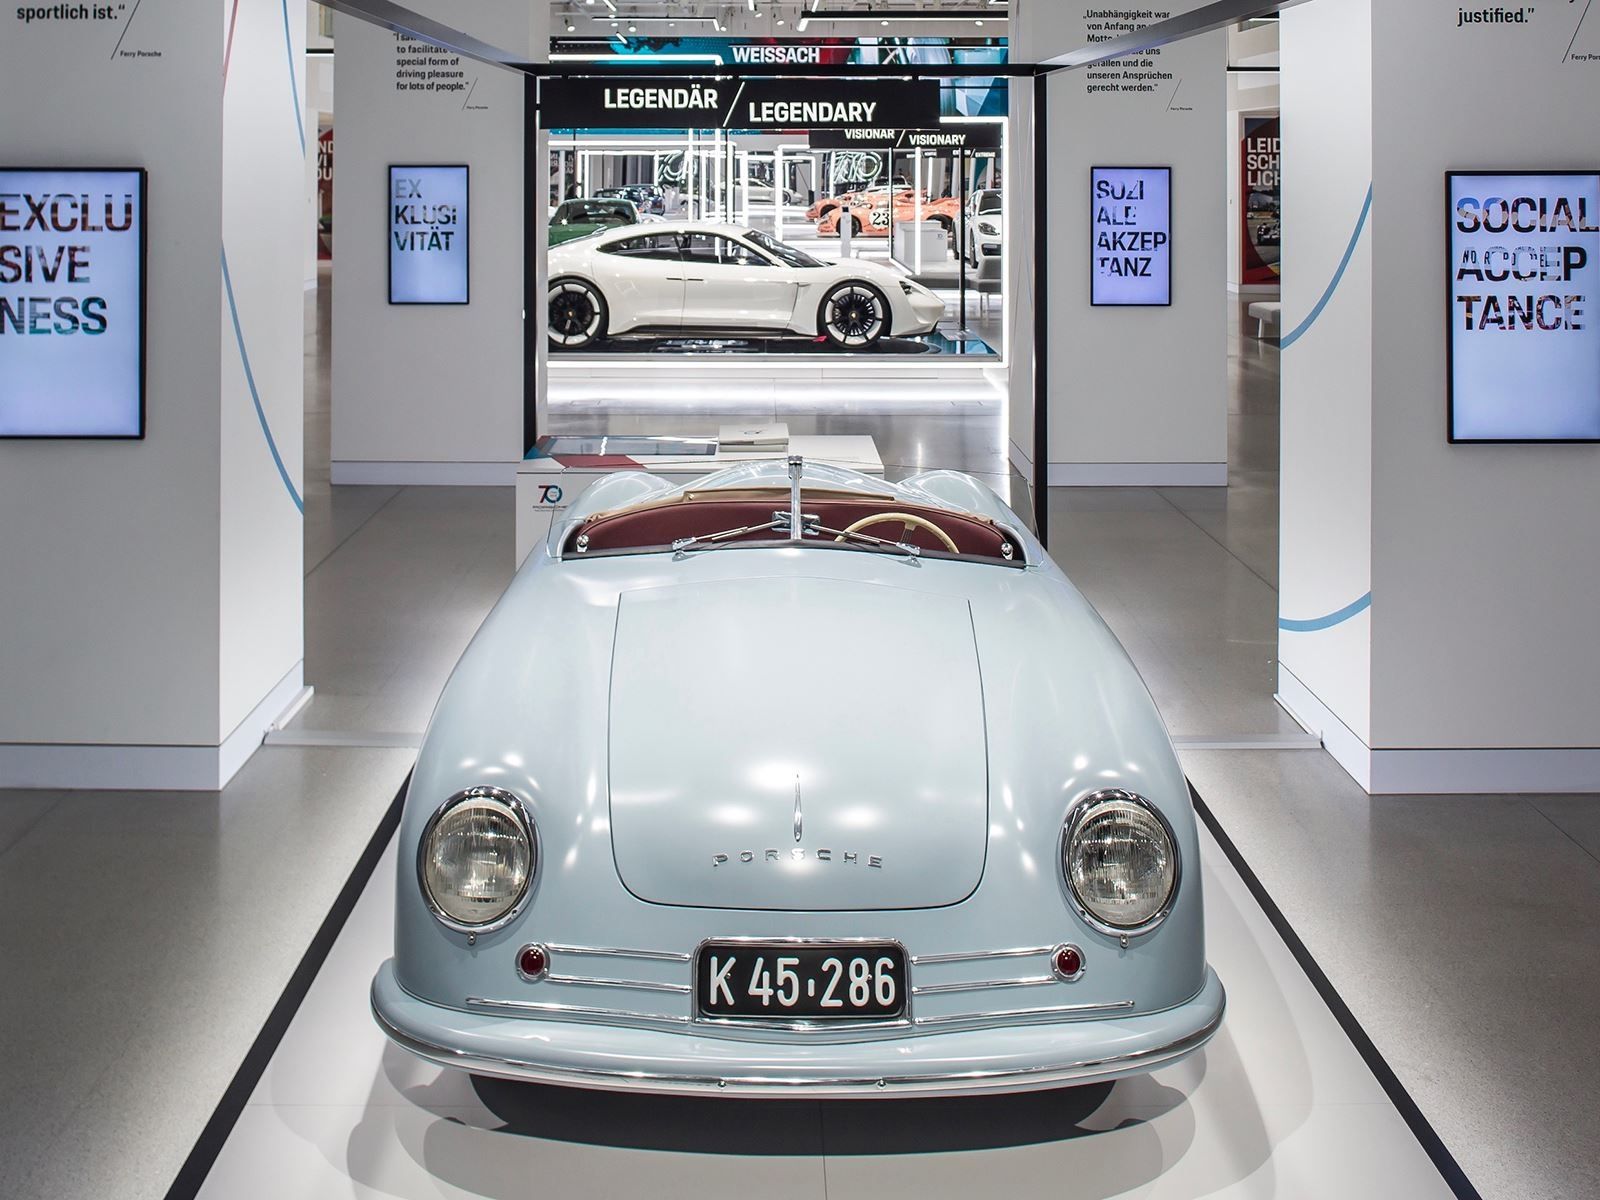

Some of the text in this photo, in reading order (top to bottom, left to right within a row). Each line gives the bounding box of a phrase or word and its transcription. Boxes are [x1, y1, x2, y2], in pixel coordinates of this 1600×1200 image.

[17, 4, 89, 23] sportlich
[1104, 22, 1134, 32] Anfang
[397, 46, 406, 54] to
[732, 47, 820, 64] WEISSACH
[396, 57, 459, 67] special form of
[1123, 59, 1138, 67] und
[1140, 59, 1153, 67] die
[396, 70, 464, 80] driving pleasure
[1122, 71, 1173, 82] Ansprüchen
[396, 82, 408, 90] for
[409, 82, 424, 90] lots
[426, 82, 434, 90] of
[1087, 84, 1119, 94] gerecht
[604, 85, 877, 123] LEGENDÄR LEGENDARY
[909, 135, 966, 146] VISIONARY
[1247, 154, 1280, 170] SCH
[395, 179, 422, 198] EX
[0, 194, 133, 232] EXCLU
[395, 205, 457, 225] KLUSI
[872, 212, 890, 226] 23
[1456, 197, 1600, 233] SOCIAL
[394, 226, 454, 251] VITÄT
[1097, 232, 1167, 251] AKZEP
[0, 246, 90, 283] SIVE
[1097, 257, 1151, 277] TANZ
[1456, 246, 1587, 282] ACCEP
[0, 297, 108, 335] NESS
[1456, 295, 1585, 331] TANCE
[711, 848, 883, 868] PORSCHE
[709, 956, 738, 1006] K
